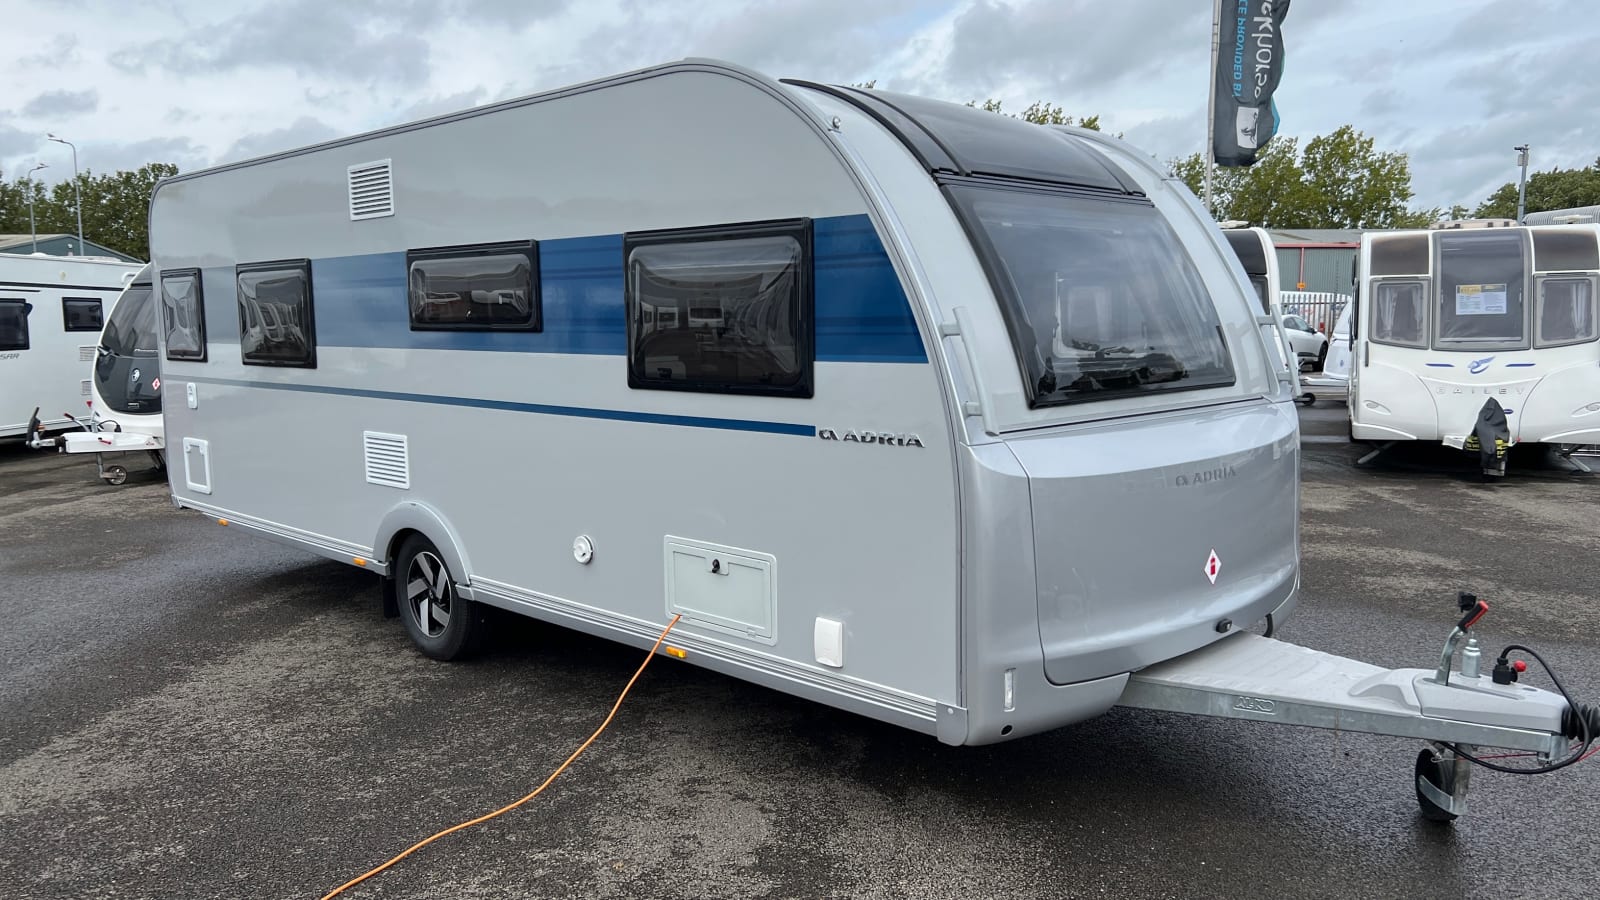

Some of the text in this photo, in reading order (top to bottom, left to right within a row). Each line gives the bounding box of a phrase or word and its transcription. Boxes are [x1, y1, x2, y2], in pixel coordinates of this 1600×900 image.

[1436, 386, 1525, 395] BAILEY
[843, 428, 926, 448] ADRIA
[1193, 465, 1237, 485] ADRIA
